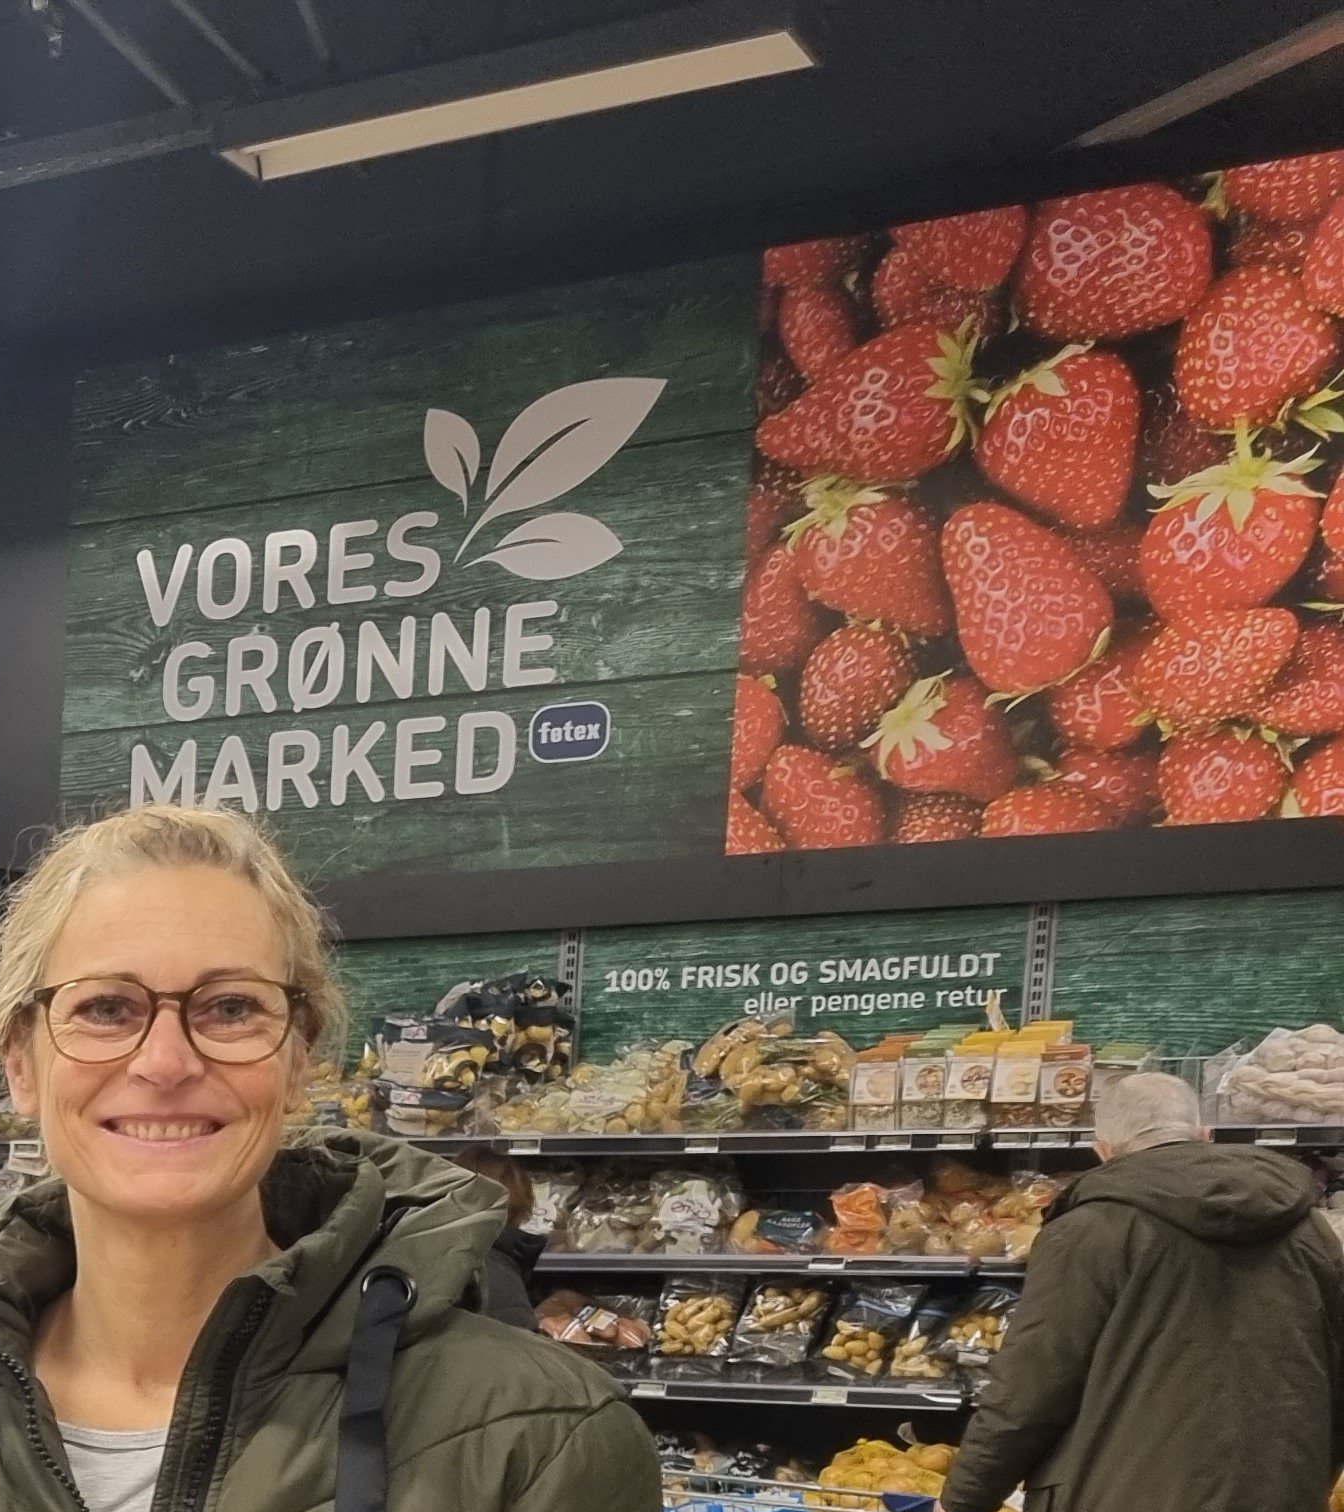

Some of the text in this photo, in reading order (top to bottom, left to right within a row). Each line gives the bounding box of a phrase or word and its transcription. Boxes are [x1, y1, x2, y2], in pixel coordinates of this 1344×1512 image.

[136, 511, 442, 628] VORES
[162, 599, 560, 722] GRØNNE
[129, 710, 601, 814] MARKED føtex
[603, 952, 1002, 993] 100% FRISK OG SMAGFULDT
[743, 986, 1009, 1018] eller pengene retur
